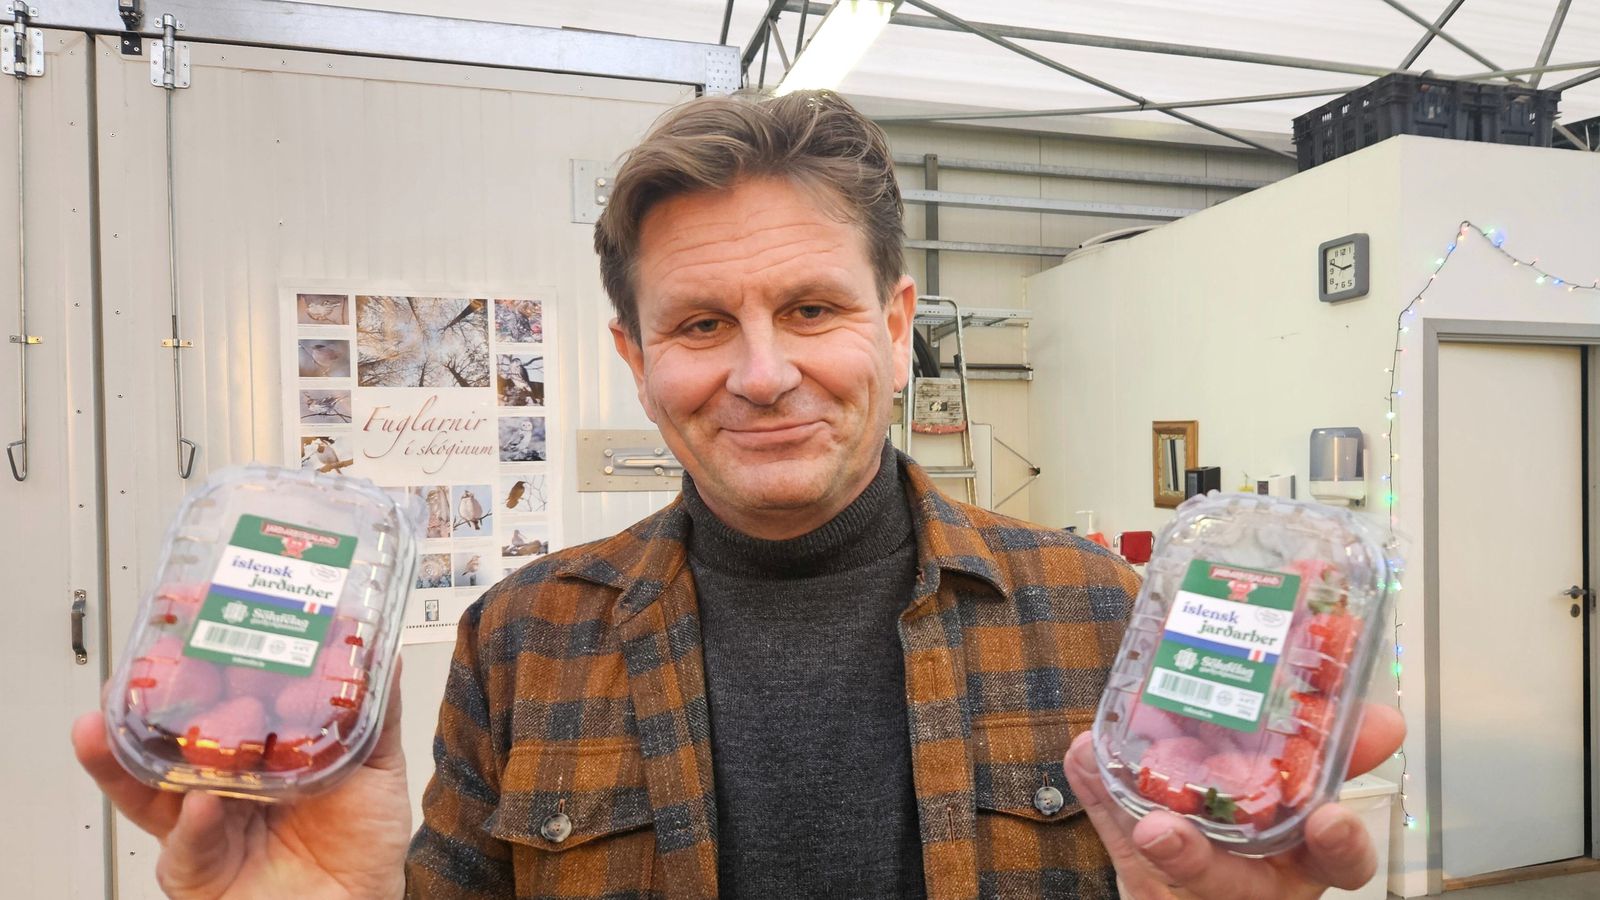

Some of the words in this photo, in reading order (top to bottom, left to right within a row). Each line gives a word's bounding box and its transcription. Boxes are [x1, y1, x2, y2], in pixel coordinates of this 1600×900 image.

[362, 394, 488, 459] Fuglarnir
[404, 439, 413, 456] í
[416, 431, 494, 475] skóginum
[231, 555, 294, 579] íslensk
[248, 574, 334, 600] jarðarber
[1182, 601, 1241, 625] íslensk
[1197, 620, 1279, 647] jarðarber
